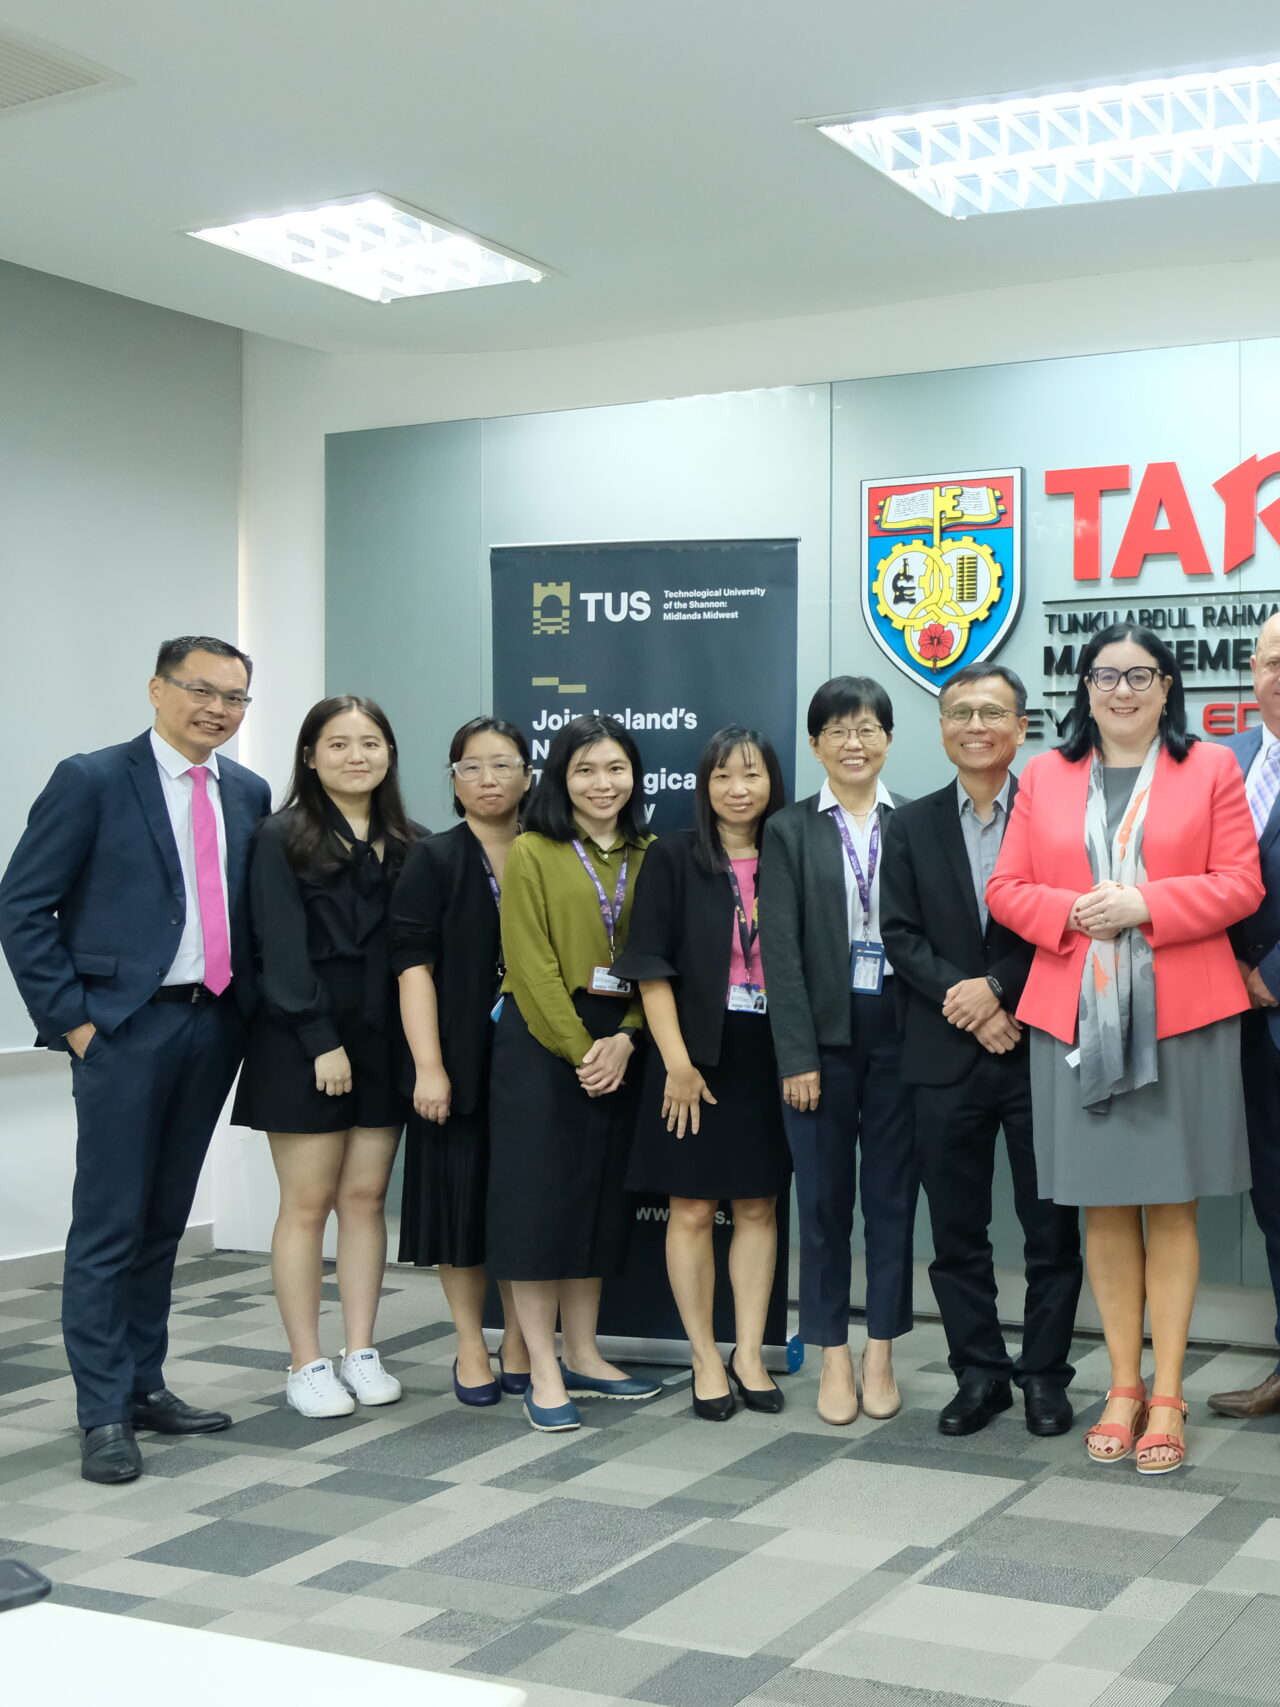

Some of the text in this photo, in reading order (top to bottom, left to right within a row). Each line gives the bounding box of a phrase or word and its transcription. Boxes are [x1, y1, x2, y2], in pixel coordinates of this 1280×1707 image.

[663, 587, 766, 599] Technological University
[579, 590, 651, 622] TUS
[663, 600, 728, 609] of the Shannon:
[663, 610, 739, 621] Midlands Midwest
[593, 707, 698, 730] eland's
